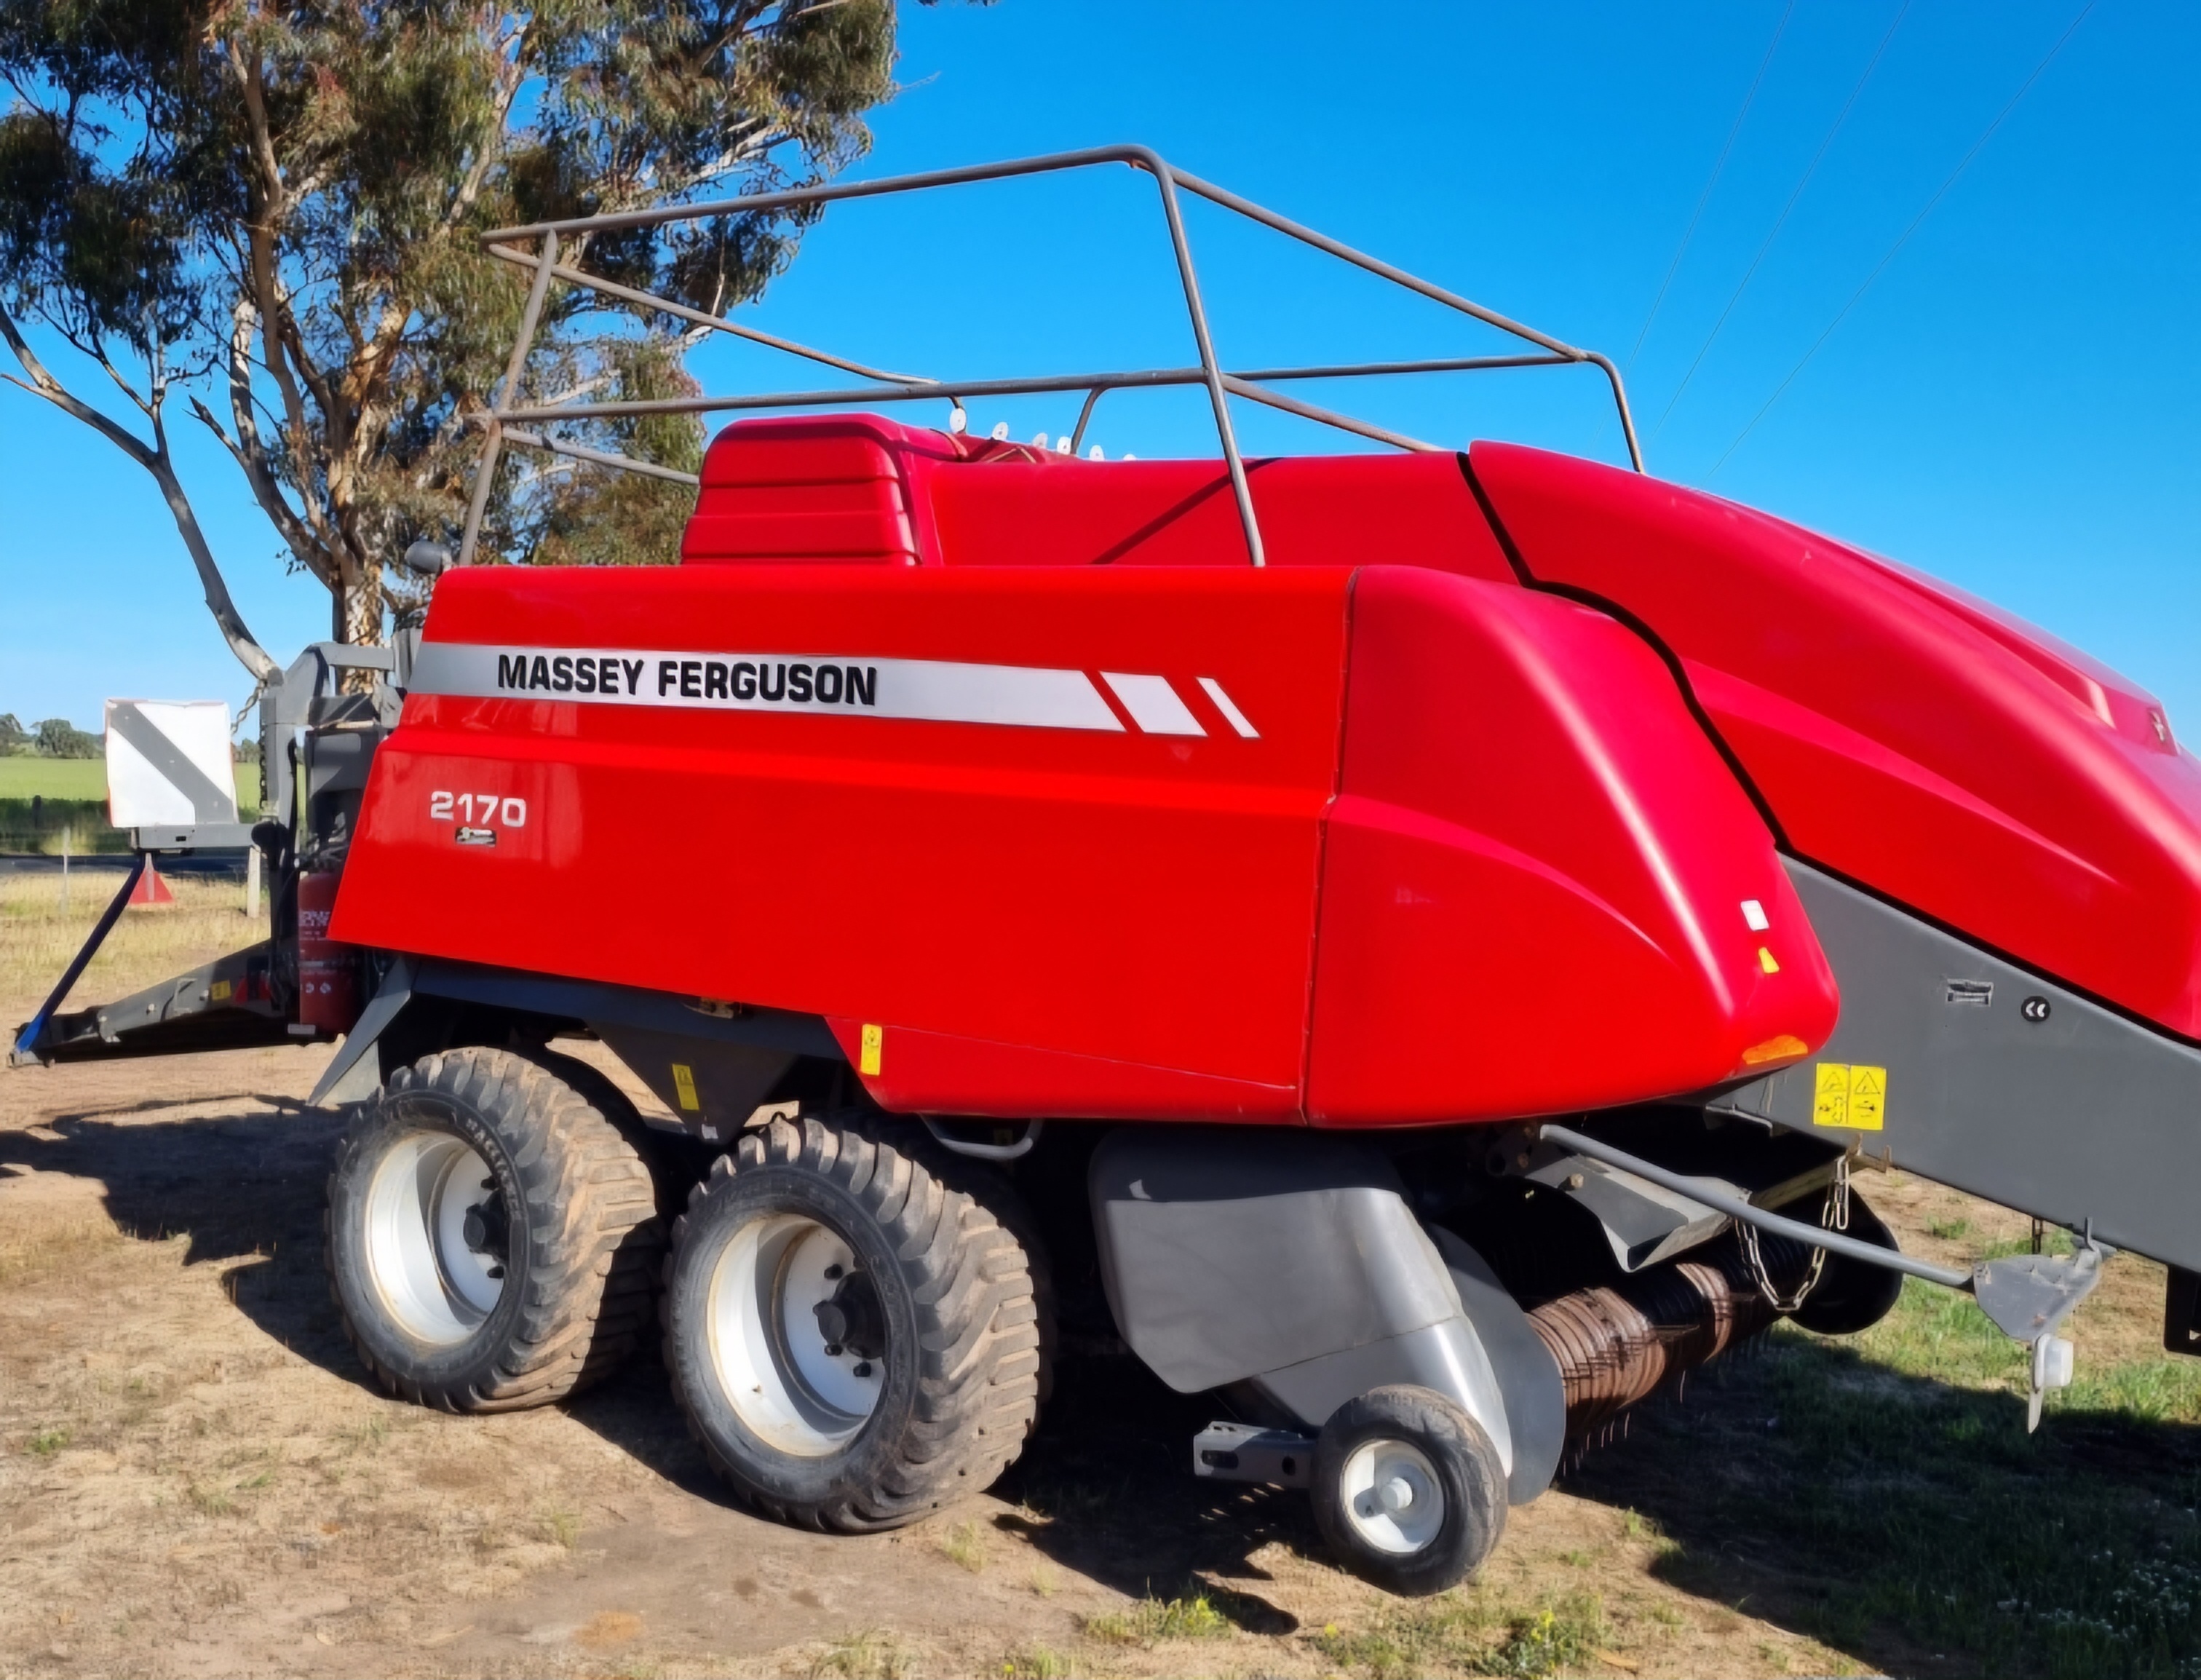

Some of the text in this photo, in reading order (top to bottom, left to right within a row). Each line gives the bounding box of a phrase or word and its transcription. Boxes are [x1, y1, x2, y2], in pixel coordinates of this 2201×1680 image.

[498, 654, 877, 705] MASSEY FERGUSON
[430, 791, 527, 828] 2170
